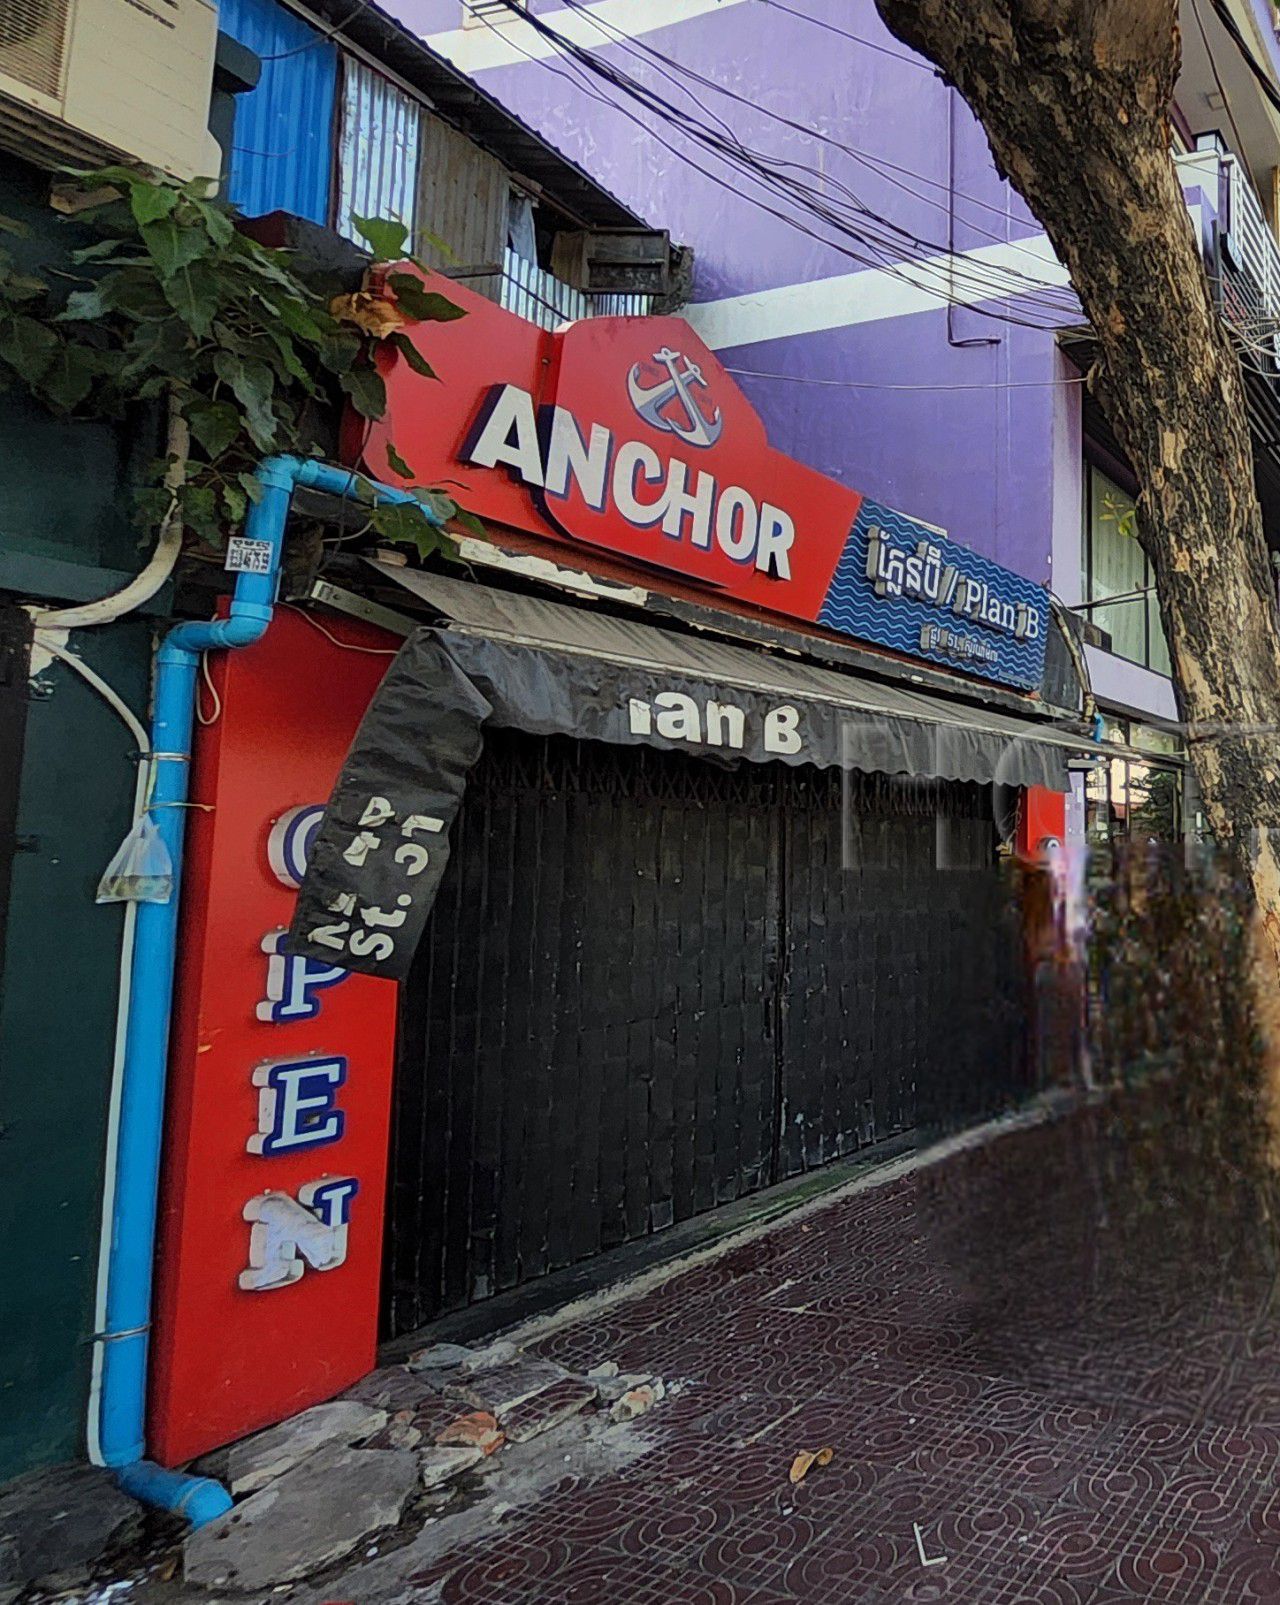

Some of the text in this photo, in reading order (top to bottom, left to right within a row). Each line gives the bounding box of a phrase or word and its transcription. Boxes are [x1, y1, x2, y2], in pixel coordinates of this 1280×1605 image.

[457, 382, 796, 582] ANCHOR
[962, 578, 1016, 632] Plan
[1022, 603, 1040, 639] B
[764, 705, 802, 754] B
